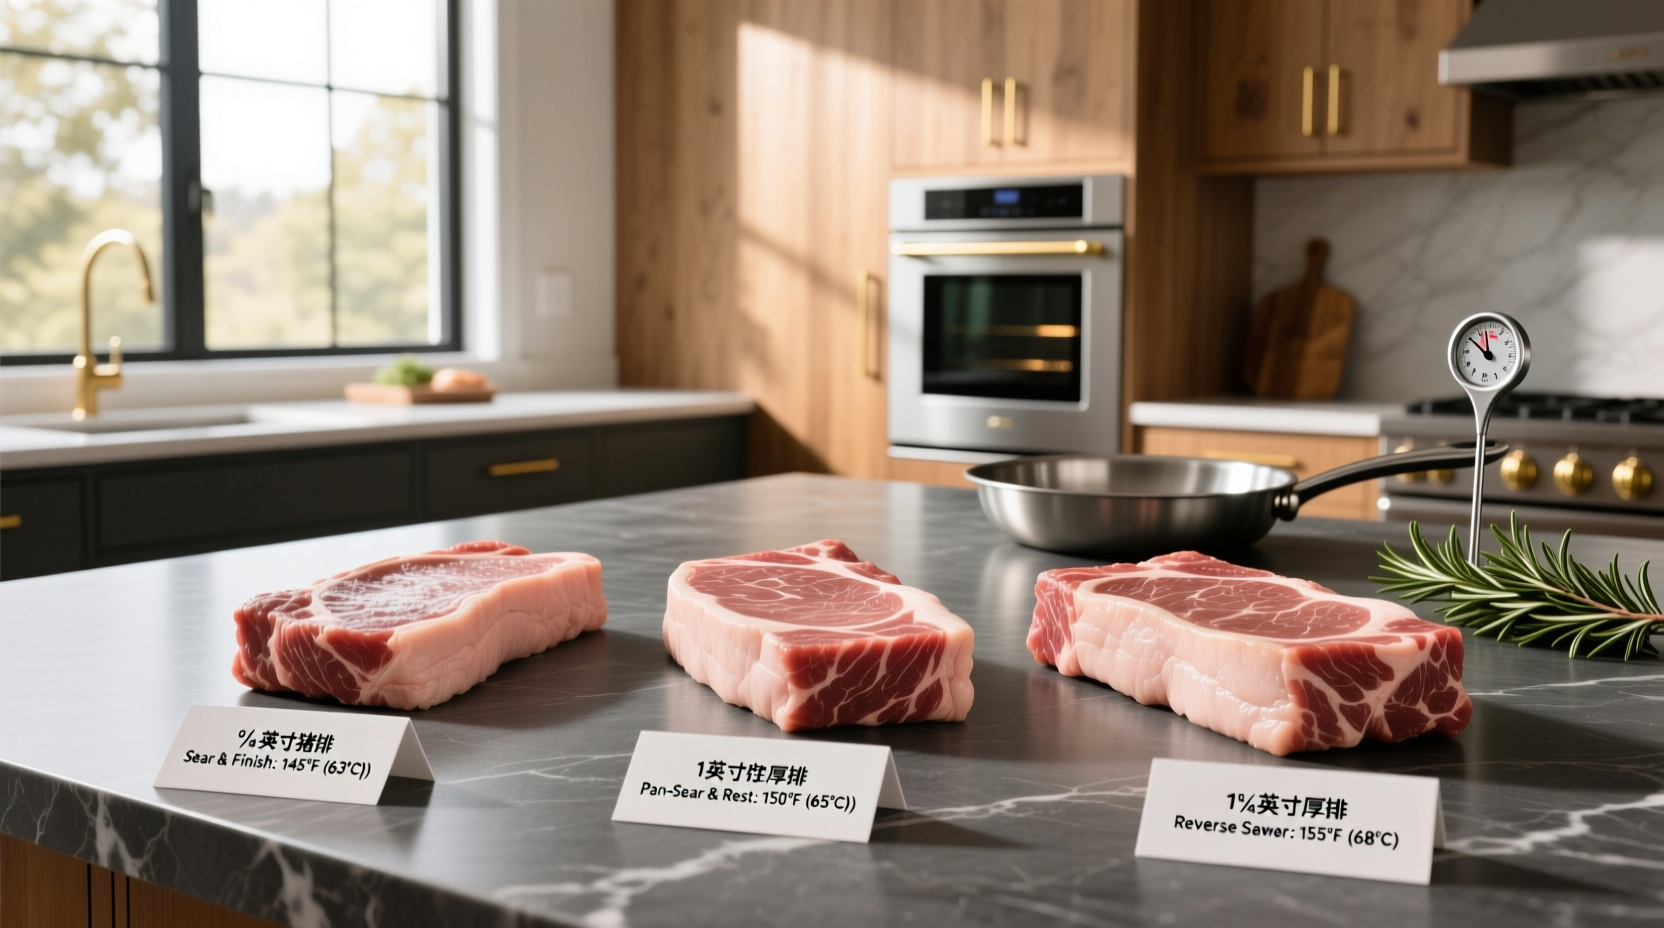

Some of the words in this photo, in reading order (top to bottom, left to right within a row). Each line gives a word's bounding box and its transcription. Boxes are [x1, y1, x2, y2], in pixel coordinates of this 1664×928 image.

[183, 749, 216, 765] Sear
[217, 752, 227, 766] &
[231, 753, 278, 770] Finish:
[640, 781, 705, 799] Pan-Sear
[707, 787, 719, 801] &
[723, 788, 759, 804] Rest:
[762, 791, 803, 807] 150°F
[1174, 815, 1238, 834] Reverse
[1300, 826, 1343, 842] 155°F
[1347, 829, 1400, 850] (68°C)
